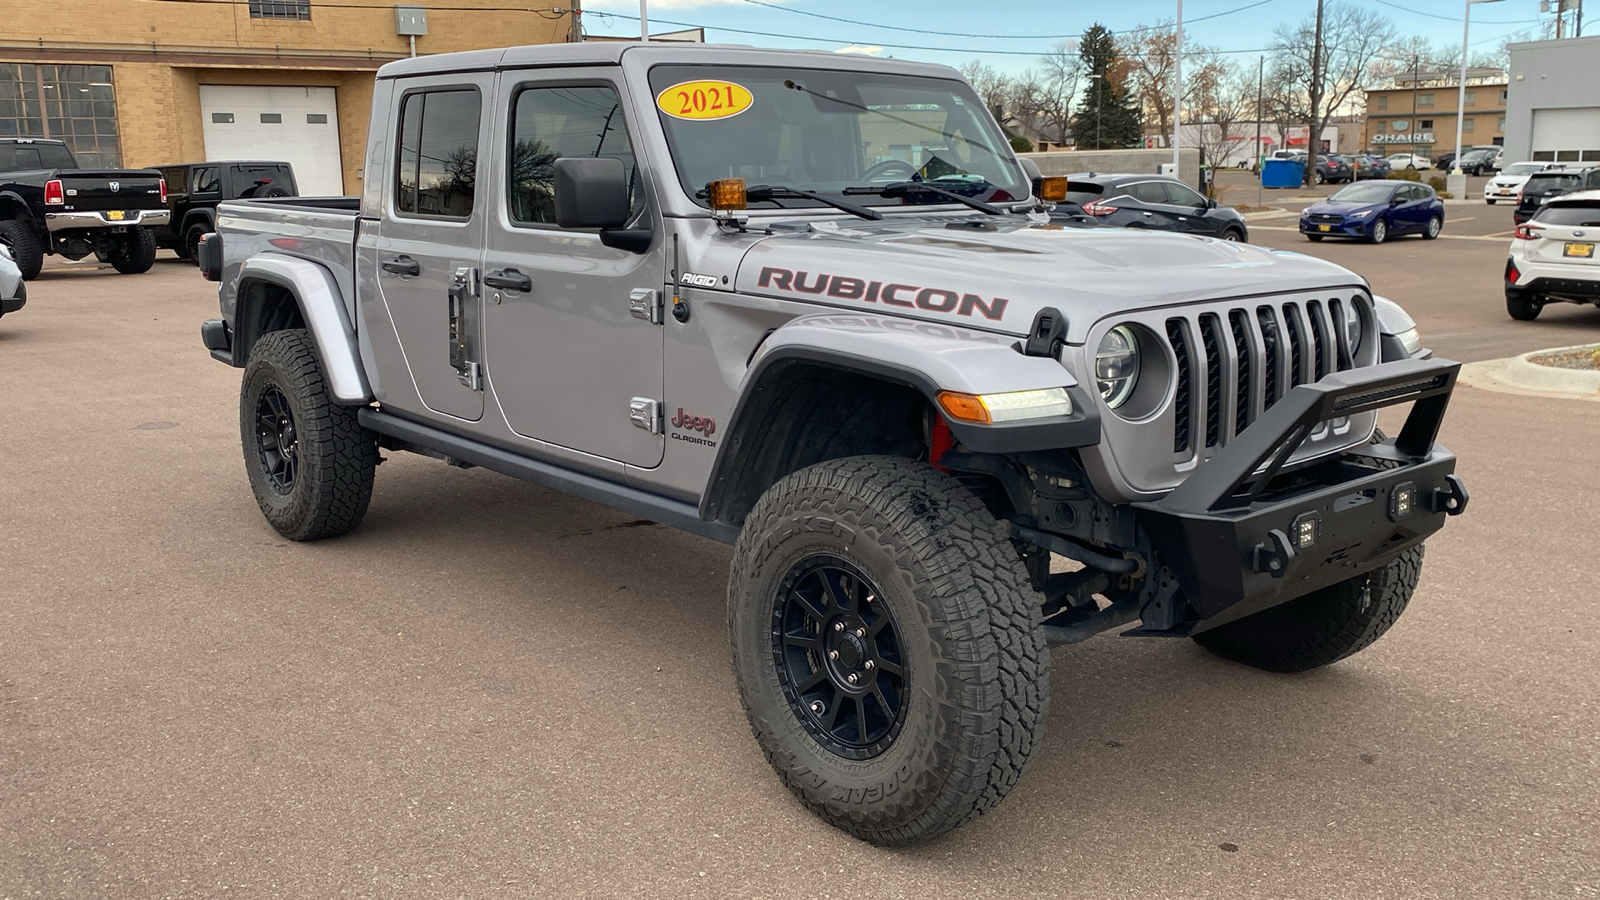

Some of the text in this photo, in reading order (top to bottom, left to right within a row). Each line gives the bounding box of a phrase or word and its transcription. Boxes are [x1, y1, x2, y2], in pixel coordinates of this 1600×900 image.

[677, 86, 736, 114] 2021
[681, 272, 718, 287] RIGID
[757, 266, 1010, 321] RUBICON
[671, 406, 716, 438] Jeep
